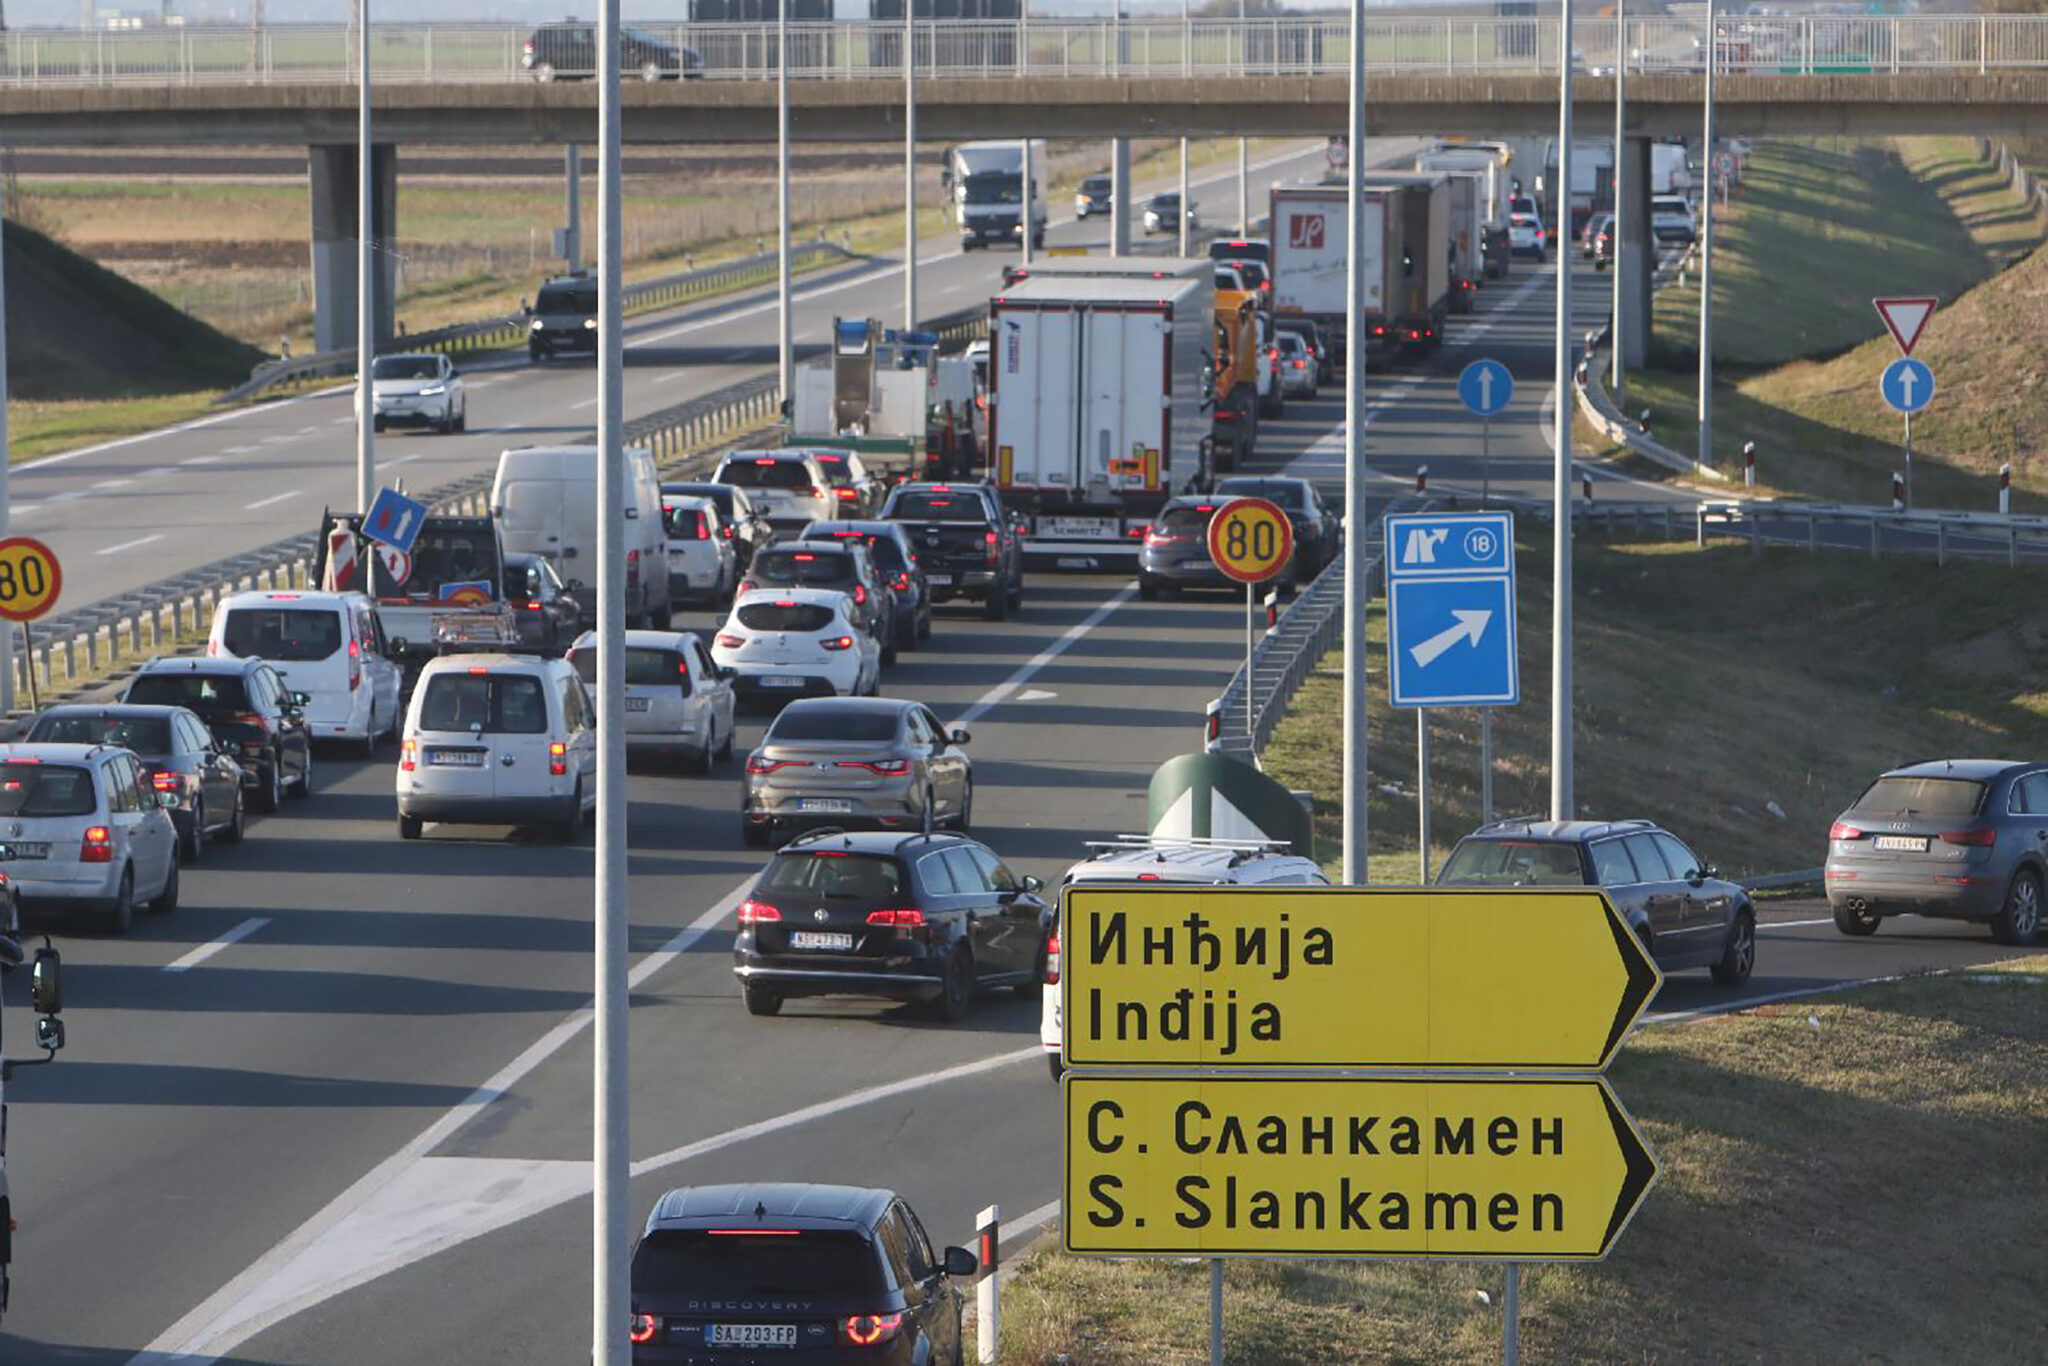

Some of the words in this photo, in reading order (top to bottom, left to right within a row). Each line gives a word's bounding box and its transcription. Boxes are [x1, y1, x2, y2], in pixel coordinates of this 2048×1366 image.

[1227, 520, 1274, 561] 80
[1472, 535, 1490, 553] 18
[0, 555, 45, 601] 80
[1090, 911, 1334, 981] Инђија
[1090, 988, 1281, 1056] Inđija
[1087, 1100, 1148, 1155] С.
[1175, 1100, 1563, 1156] Сланкамен
[1087, 1174, 1145, 1229] S.
[1175, 1175, 1563, 1232] Slankamen
[688, 1301, 813, 1310] DISCOVERY
